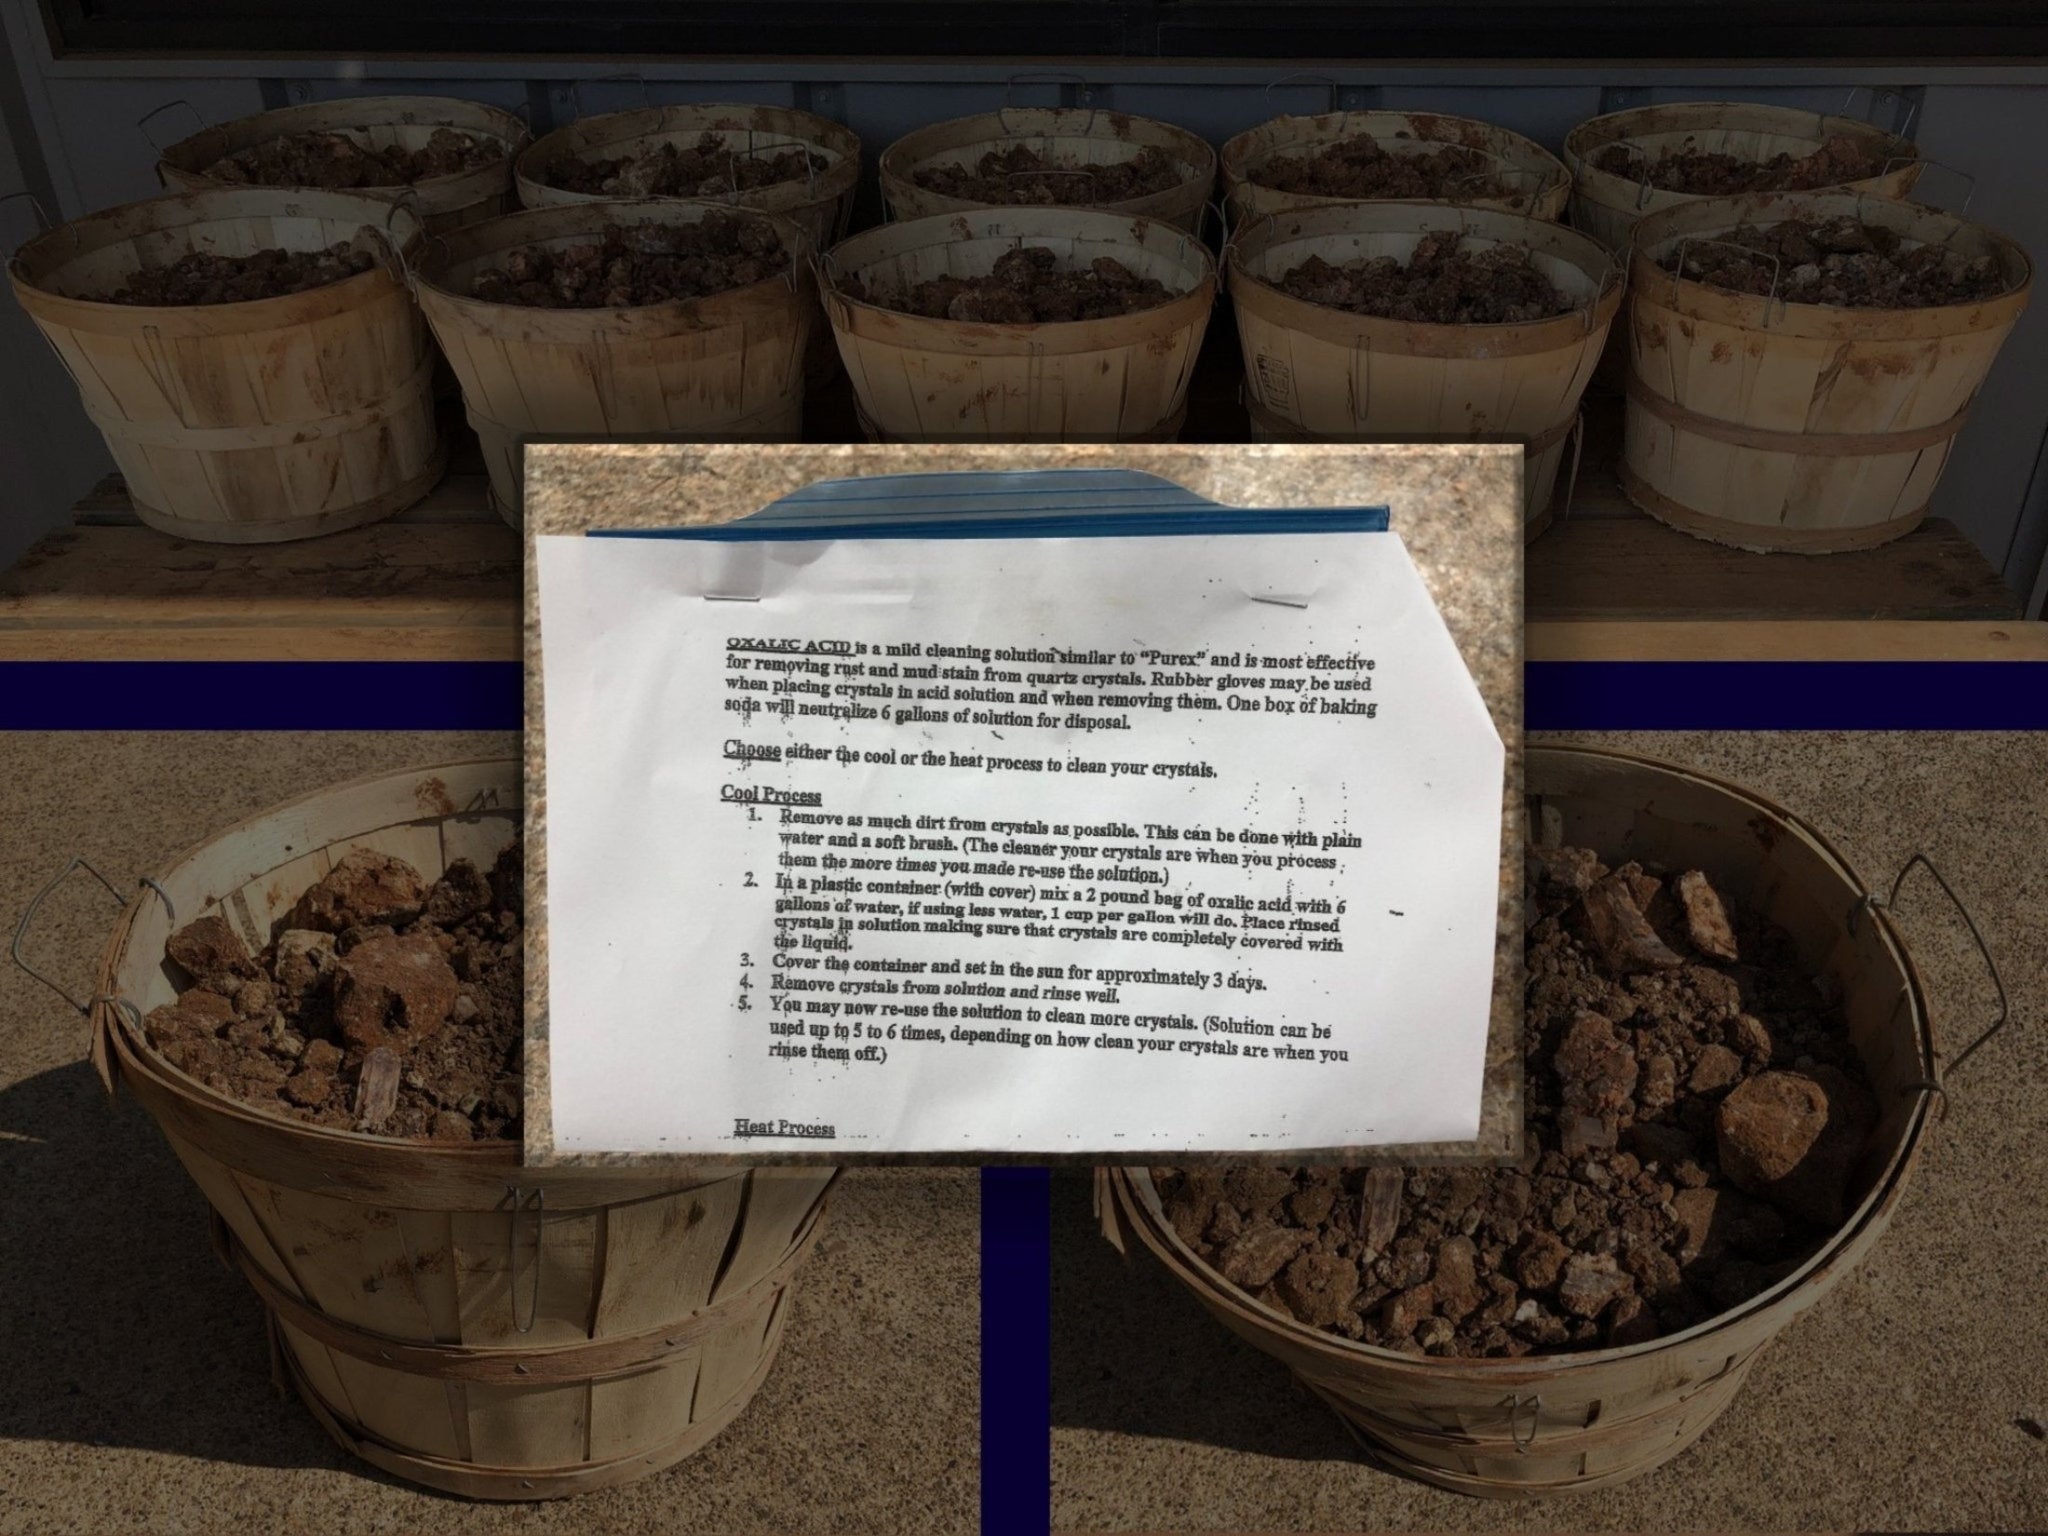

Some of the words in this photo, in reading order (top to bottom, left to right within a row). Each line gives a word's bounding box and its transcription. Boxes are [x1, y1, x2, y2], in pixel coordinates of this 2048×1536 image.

[725, 637, 801, 655] OXALIC
[803, 640, 851, 657] ACID
[854, 640, 867, 655] is
[871, 644, 882, 656] a
[885, 641, 921, 657] mild
[925, 643, 991, 664] cleaning
[994, 646, 1054, 663] solution
[1058, 648, 1116, 664] similar
[1120, 650, 1136, 665] to
[1210, 652, 1240, 667] and
[1244, 652, 1258, 668] is
[1262, 654, 1304, 669] most
[1306, 654, 1375, 671] effective
[725, 653, 751, 669] for
[754, 657, 830, 677] removing
[833, 660, 865, 676] rust
[868, 662, 899, 678] and
[902, 664, 936, 679] mud
[942, 665, 980, 681] stain
[982, 666, 1022, 683] from
[1026, 669, 1078, 687] quartz
[1081, 670, 1146, 689] crystals.
[1150, 671, 1213, 688] Rubber
[1216, 673, 1266, 691] gloves
[1268, 677, 1304, 693] may
[1310, 675, 1330, 691] be
[1333, 676, 1372, 692] used
[724, 696, 762, 712] soda
[764, 698, 795, 714] will
[797, 701, 878, 719] neutralize
[880, 705, 890, 720] 6
[894, 706, 949, 724] gallons
[952, 708, 969, 723] of
[972, 710, 1034, 727] solution
[1036, 712, 1061, 728] for
[1064, 713, 1131, 732] disposal.
[723, 740, 782, 757] Choose
[784, 743, 832, 760] either
[834, 746, 860, 762] the
[863, 749, 896, 764] cool
[900, 753, 918, 765] or
[920, 750, 946, 766] the
[949, 752, 984, 768] heat
[986, 757, 1043, 772] process
[1046, 756, 1062, 772] to
[1066, 757, 1106, 774] clean
[1110, 762, 1149, 777] your
[720, 783, 758, 800] Cool
[763, 786, 822, 803] Process
[748, 806, 762, 822] 1.
[779, 808, 843, 826] Remove
[846, 815, 863, 827] as
[866, 813, 912, 829] much
[915, 814, 946, 830] dirt
[948, 815, 986, 832] from
[990, 819, 1049, 837] crystals
[1052, 824, 1069, 836] as
[1072, 822, 1139, 840] possible.
[1144, 824, 1179, 840] This
[1182, 829, 1212, 842] can
[1216, 827, 1235, 843] be
[1238, 828, 1279, 845] done
[1280, 830, 1318, 846] with
[1322, 832, 1362, 850] plain
[778, 851, 817, 868] them
[820, 853, 847, 869] the
[849, 858, 892, 870] more
[895, 855, 937, 872] times
[940, 860, 970, 876] you
[972, 860, 1016, 876] made
[1018, 865, 1066, 878] re-use
[1068, 864, 1094, 880] the
[1096, 866, 1170, 887] solution.)
[742, 871, 758, 888] 2.
[774, 873, 794, 889] In
[796, 878, 808, 890] a
[810, 875, 862, 894] plastic
[866, 879, 942, 895] container
[943, 880, 984, 899] (with
[988, 884, 1036, 903] cover)
[1039, 885, 1069, 901] mix
[1072, 890, 1082, 902] a
[1085, 887, 1096, 902] 2
[1099, 889, 1150, 906] pound
[1154, 890, 1183, 910] bag
[1186, 892, 1204, 908] of
[1206, 894, 1254, 910] oxalic
[1256, 896, 1292, 912] acid
[1294, 898, 1332, 914] with
[1336, 899, 1346, 915] 6
[774, 896, 830, 914] gallons
[836, 898, 852, 913] of
[853, 899, 904, 917] water,
[907, 900, 921, 916] if
[922, 901, 966, 920] using
[967, 902, 996, 918] less
[998, 903, 1047, 921] water,
[1050, 905, 1060, 920] 1
[1064, 909, 1094, 925] cup
[1096, 910, 1124, 925] per
[1126, 908, 1176, 926] gallon
[1178, 910, 1210, 926] will
[1213, 911, 1238, 927] do.
[1240, 913, 1285, 930] Place
[1288, 916, 1340, 933] rinsed
[773, 933, 798, 949] the
[801, 934, 853, 953] liquid.
[739, 973, 753, 989] 4.
[770, 974, 835, 992] Remove
[838, 978, 899, 996] crystals
[902, 979, 940, 995] from
[943, 981, 1006, 998] solution
[1009, 984, 1039, 999] and
[1042, 985, 1081, 1001] rinse
[740, 952, 754, 968] 3.
[772, 952, 820, 969] Cover
[824, 955, 850, 971] the
[852, 957, 928, 973] container
[930, 959, 961, 974] and
[964, 959, 987, 975] set
[988, 960, 1004, 975] in
[1008, 961, 1034, 977] the
[1036, 966, 1064, 979] sun
[1067, 964, 1092, 980] for
[1095, 968, 1210, 990] approximately
[1212, 972, 1223, 987] 3
[1226, 973, 1267, 993] days.
[737, 995, 752, 1010] 5.
[772, 996, 802, 1012] You
[804, 1001, 841, 1017] may
[843, 1002, 878, 1015] now
[880, 1003, 929, 1016] re-use
[931, 1002, 958, 1018] the
[960, 1003, 1022, 1020] solution
[1026, 1006, 1042, 1021] to
[1044, 1008, 1085, 1024] clean
[1090, 1013, 1130, 1026] more
[1133, 1013, 1198, 1031] crystals.
[1202, 1016, 1274, 1036] (Solution
[1279, 1025, 1308, 1038] can
[1311, 1024, 1331, 1039] be
[768, 1042, 807, 1058] rinse
[810, 1043, 850, 1060] them
[854, 1045, 888, 1065] off.)
[735, 1117, 774, 1134] Heat
[779, 1119, 835, 1136] Process
